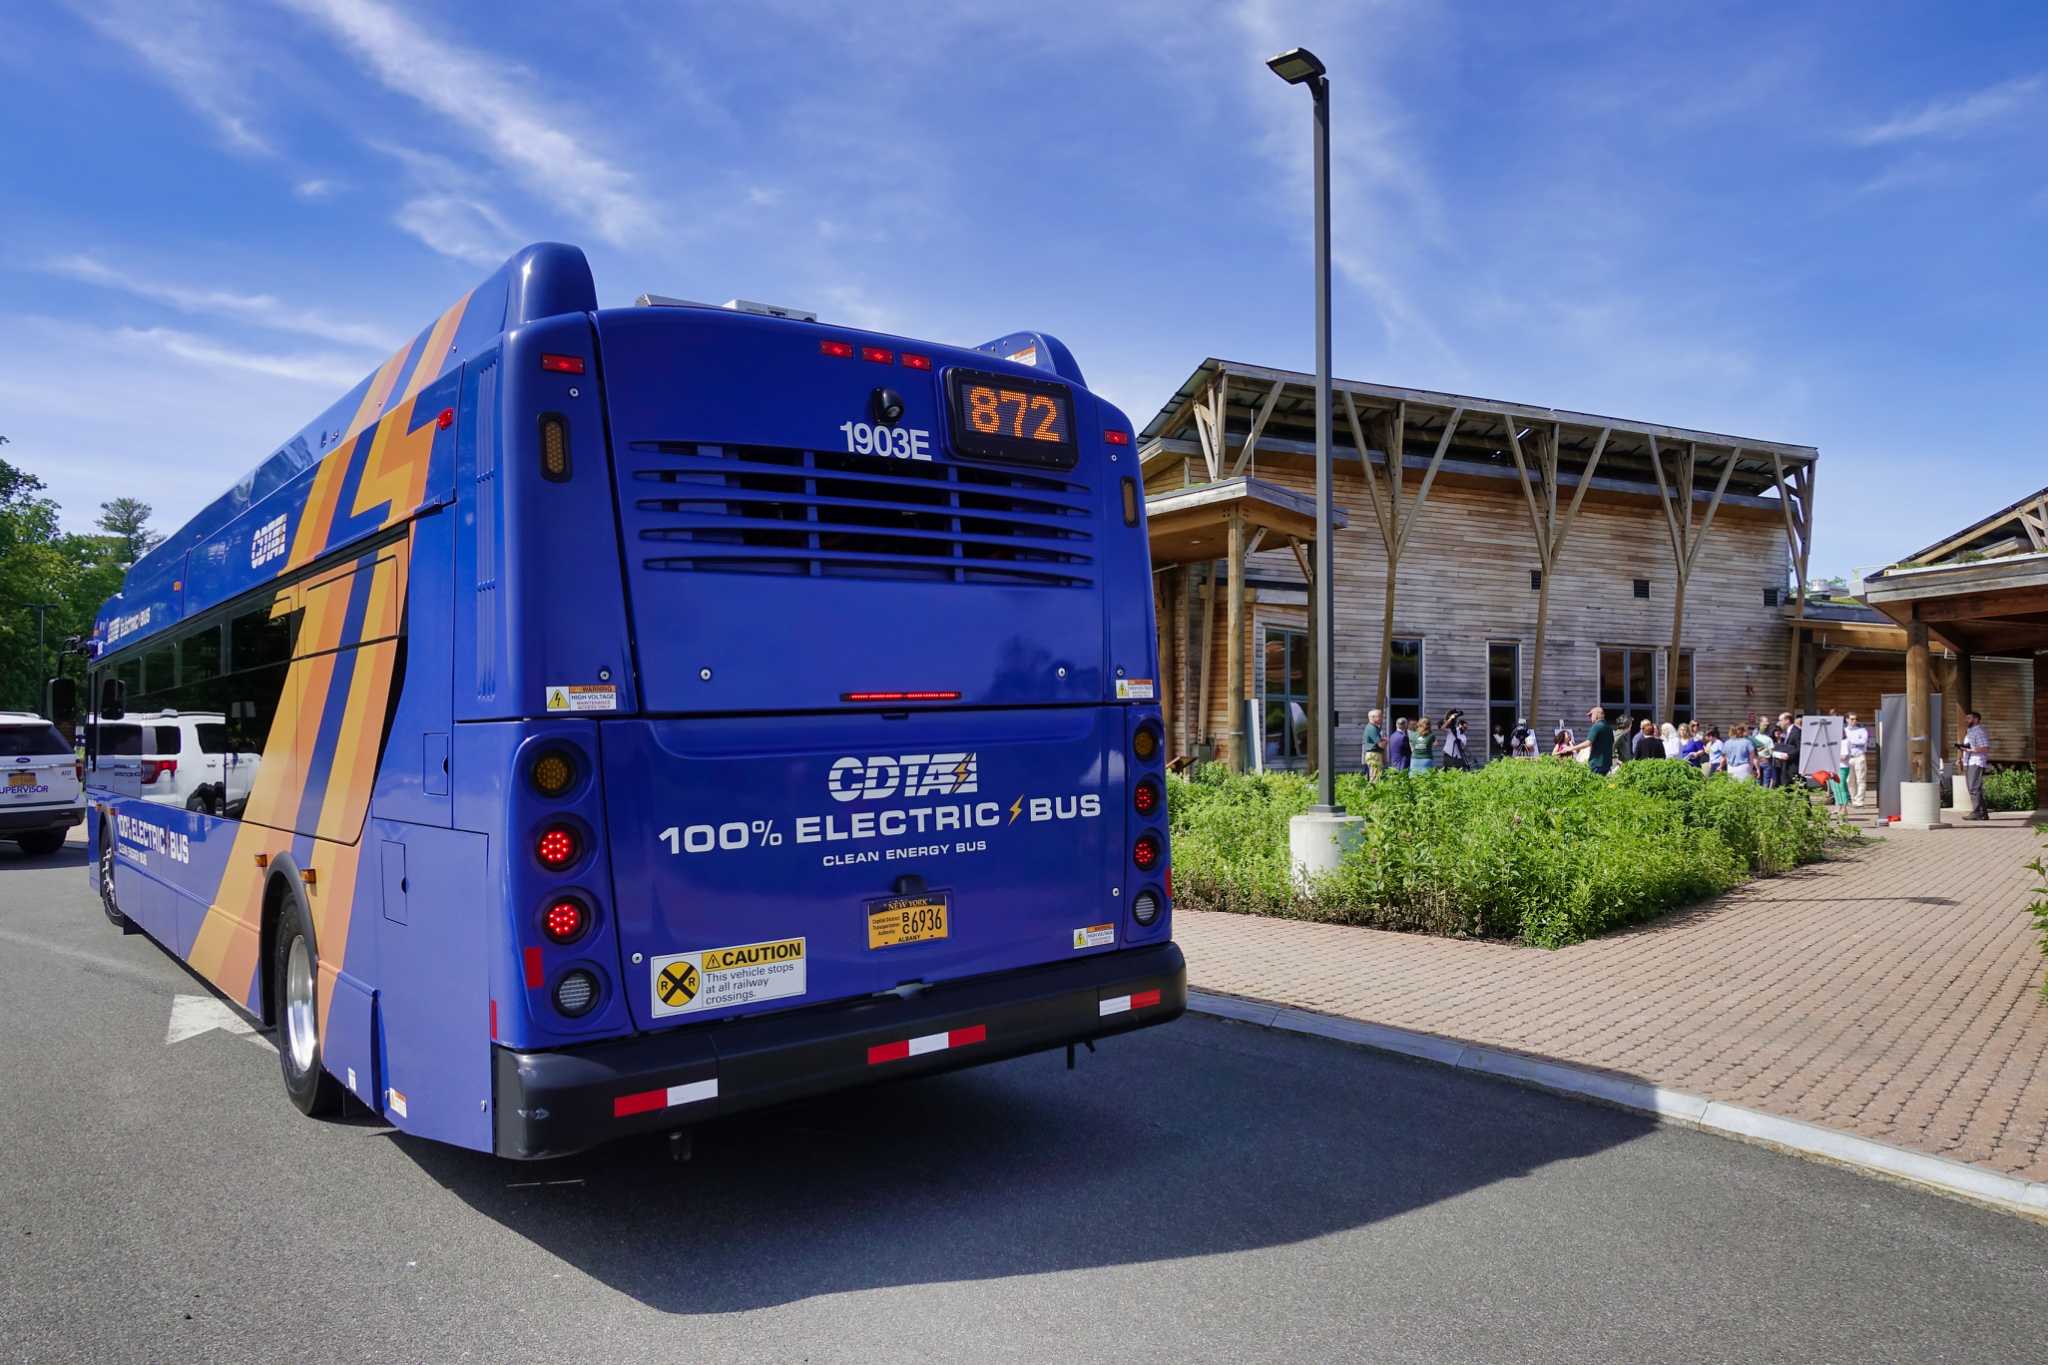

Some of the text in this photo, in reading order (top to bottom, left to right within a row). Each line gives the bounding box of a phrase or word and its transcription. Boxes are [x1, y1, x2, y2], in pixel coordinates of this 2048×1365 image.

[969, 386, 1061, 442] 872
[840, 421, 932, 462] 1903E
[0, 784, 49, 794] UPERVISOR
[828, 752, 978, 802] CDTA
[658, 793, 1101, 855] 100% ELECTRIC BUS
[169, 830, 190, 865] BUS
[822, 840, 987, 867] CLEAN ENERGY BUS
[908, 897, 929, 908] YORK
[911, 907, 943, 933] 6936
[722, 942, 801, 967] CAUTION
[661, 976, 696, 991] R R
[705, 977, 770, 994] at all railway
[706, 963, 795, 983] This vehicle stops
[705, 990, 756, 1005] crossings.
